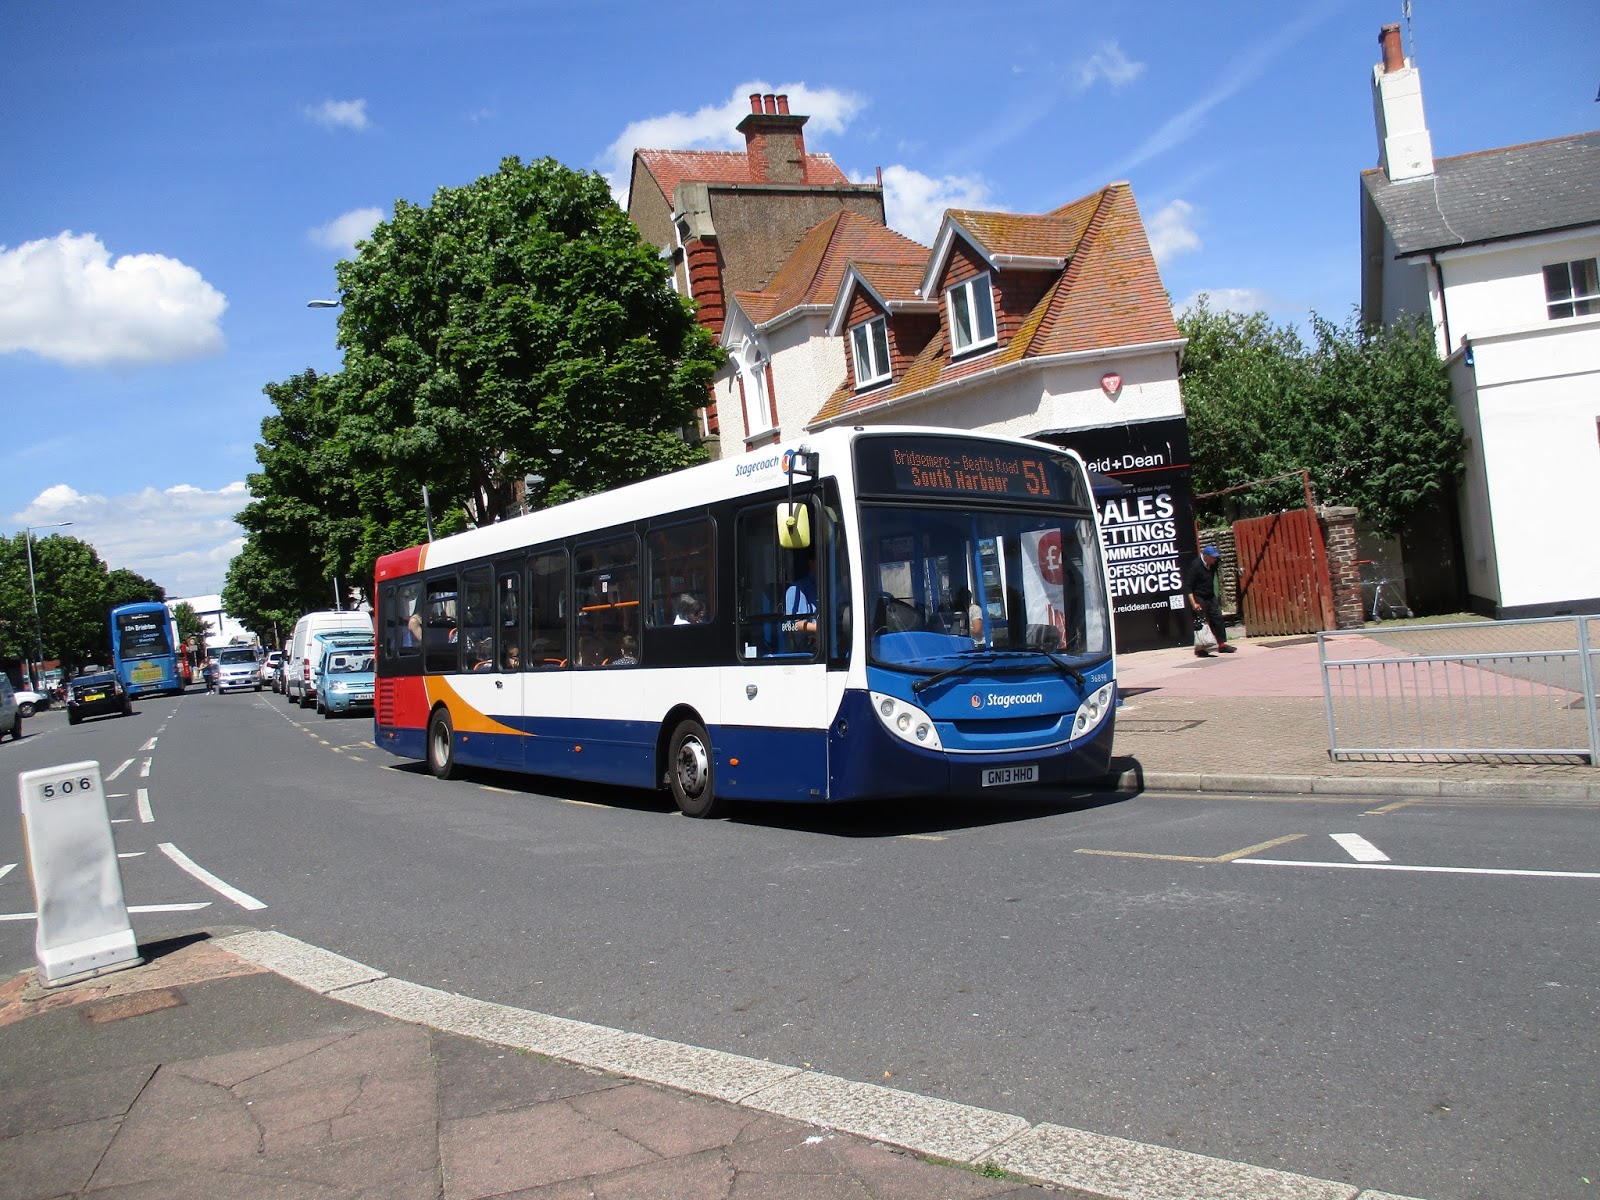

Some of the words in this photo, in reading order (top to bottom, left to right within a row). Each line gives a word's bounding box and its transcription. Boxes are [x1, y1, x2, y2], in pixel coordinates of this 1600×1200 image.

[735, 455, 780, 477] Stagecoach
[961, 455, 994, 473] Beatty
[995, 458, 1020, 475] Road
[911, 467, 952, 489] South
[954, 470, 1009, 492] Harbour
[1022, 460, 1051, 495] 51
[1101, 521, 1176, 546] ETTINGS
[1104, 541, 1179, 561] MMERCIAL
[1108, 559, 1180, 579] OFESSIONAL
[1110, 572, 1183, 597] ERVICES
[987, 691, 1043, 709] Stagecoach
[988, 768, 1011, 784] GN13
[44, 777, 90, 798] 506
